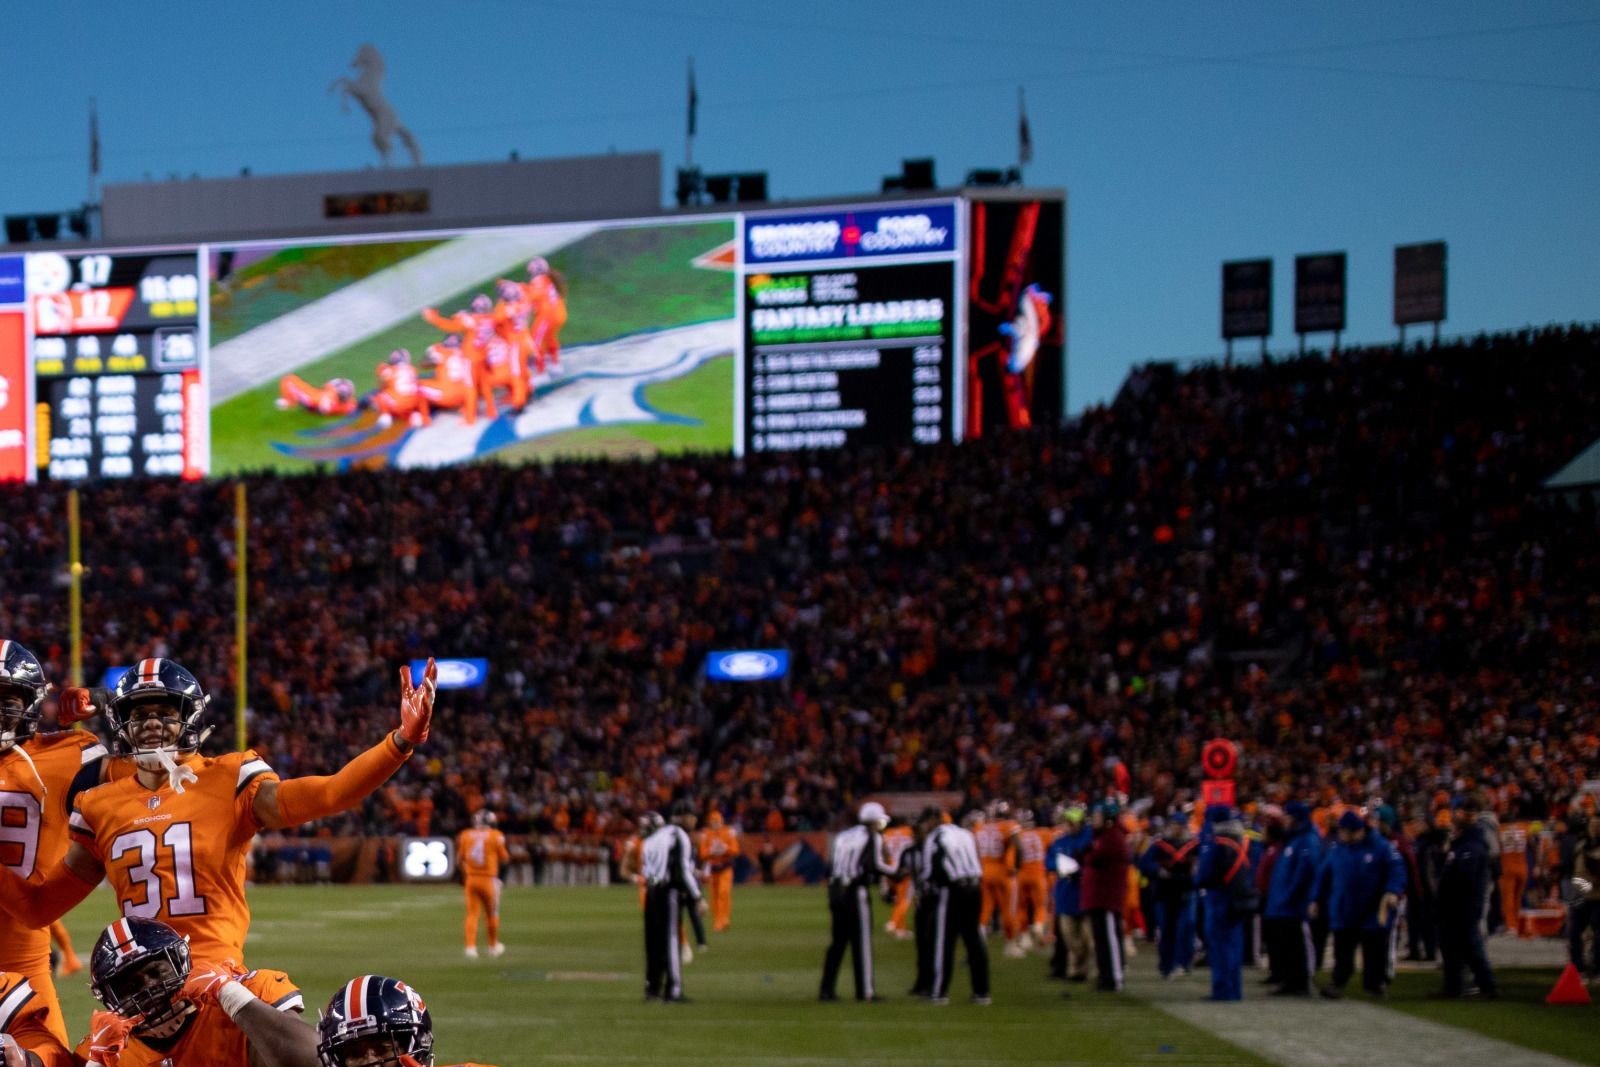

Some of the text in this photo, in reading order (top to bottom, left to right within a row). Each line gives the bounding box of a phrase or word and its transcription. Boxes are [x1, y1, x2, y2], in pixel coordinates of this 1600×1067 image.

[752, 298, 944, 331] FANTASY LEADERS
[111, 822, 208, 919] 31
